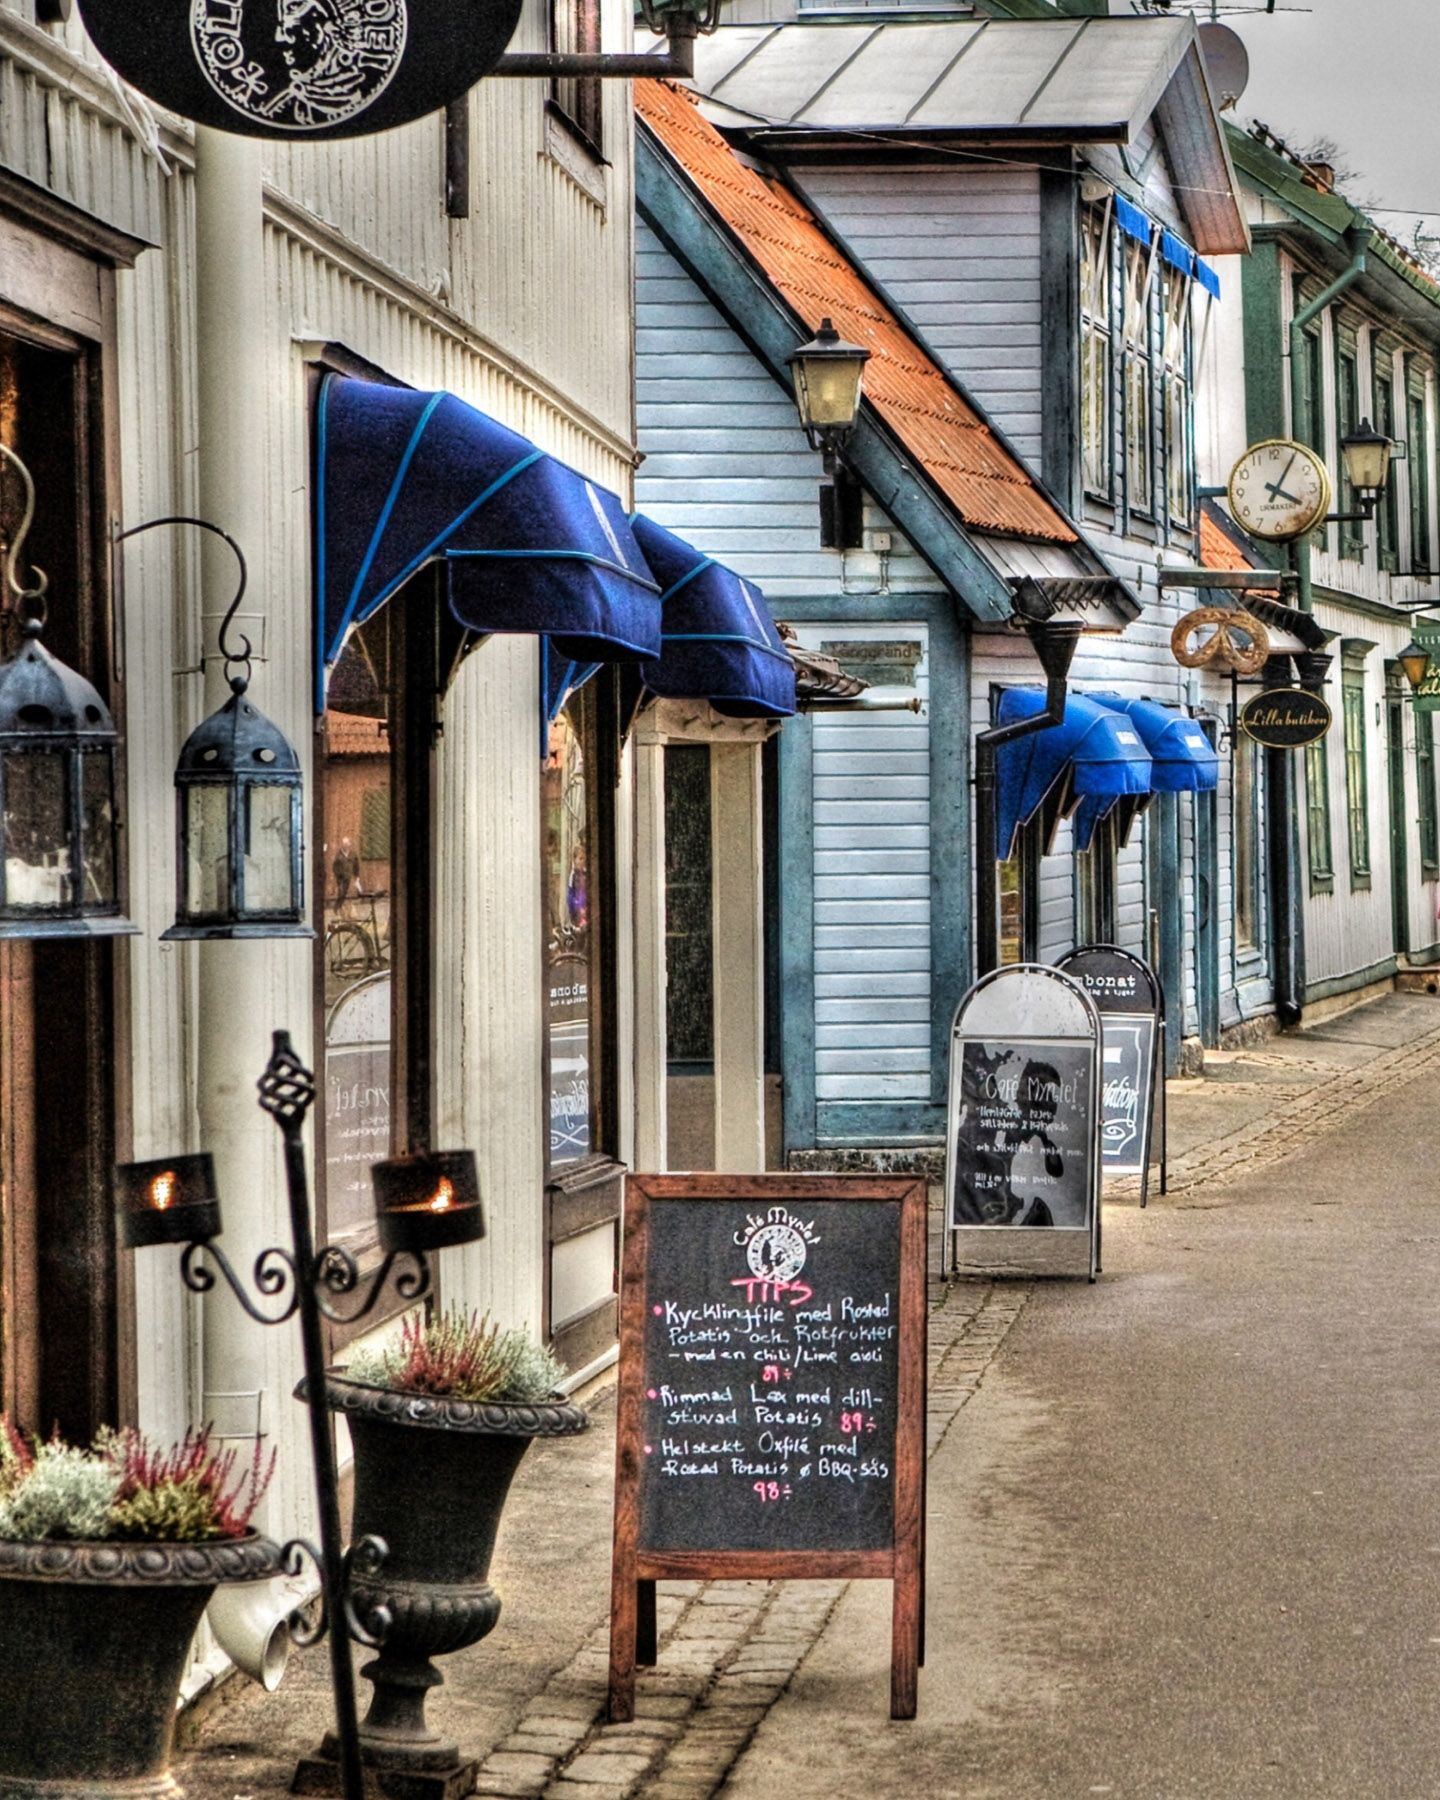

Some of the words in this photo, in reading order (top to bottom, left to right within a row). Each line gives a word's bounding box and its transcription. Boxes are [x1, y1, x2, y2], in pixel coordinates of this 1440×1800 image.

[1245, 709, 1281, 726] Lilla
[1285, 710, 1327, 726] butiken
[733, 1214, 765, 1245] Café
[768, 1207, 821, 1245] Myntet
[730, 1278, 813, 1305] TIPS
[795, 1303, 832, 1323] med
[669, 1327, 731, 1345] Potatis
[794, 1325, 896, 1347] Rotfrukter
[661, 1385, 733, 1407] Rimmad
[795, 1387, 831, 1404] med
[668, 1408, 738, 1426] stuvad
[755, 1406, 822, 1427] Potatis
[662, 1439, 745, 1456] Helstekt
[820, 1437, 858, 1456] med
[732, 1458, 788, 1475] Potatis
